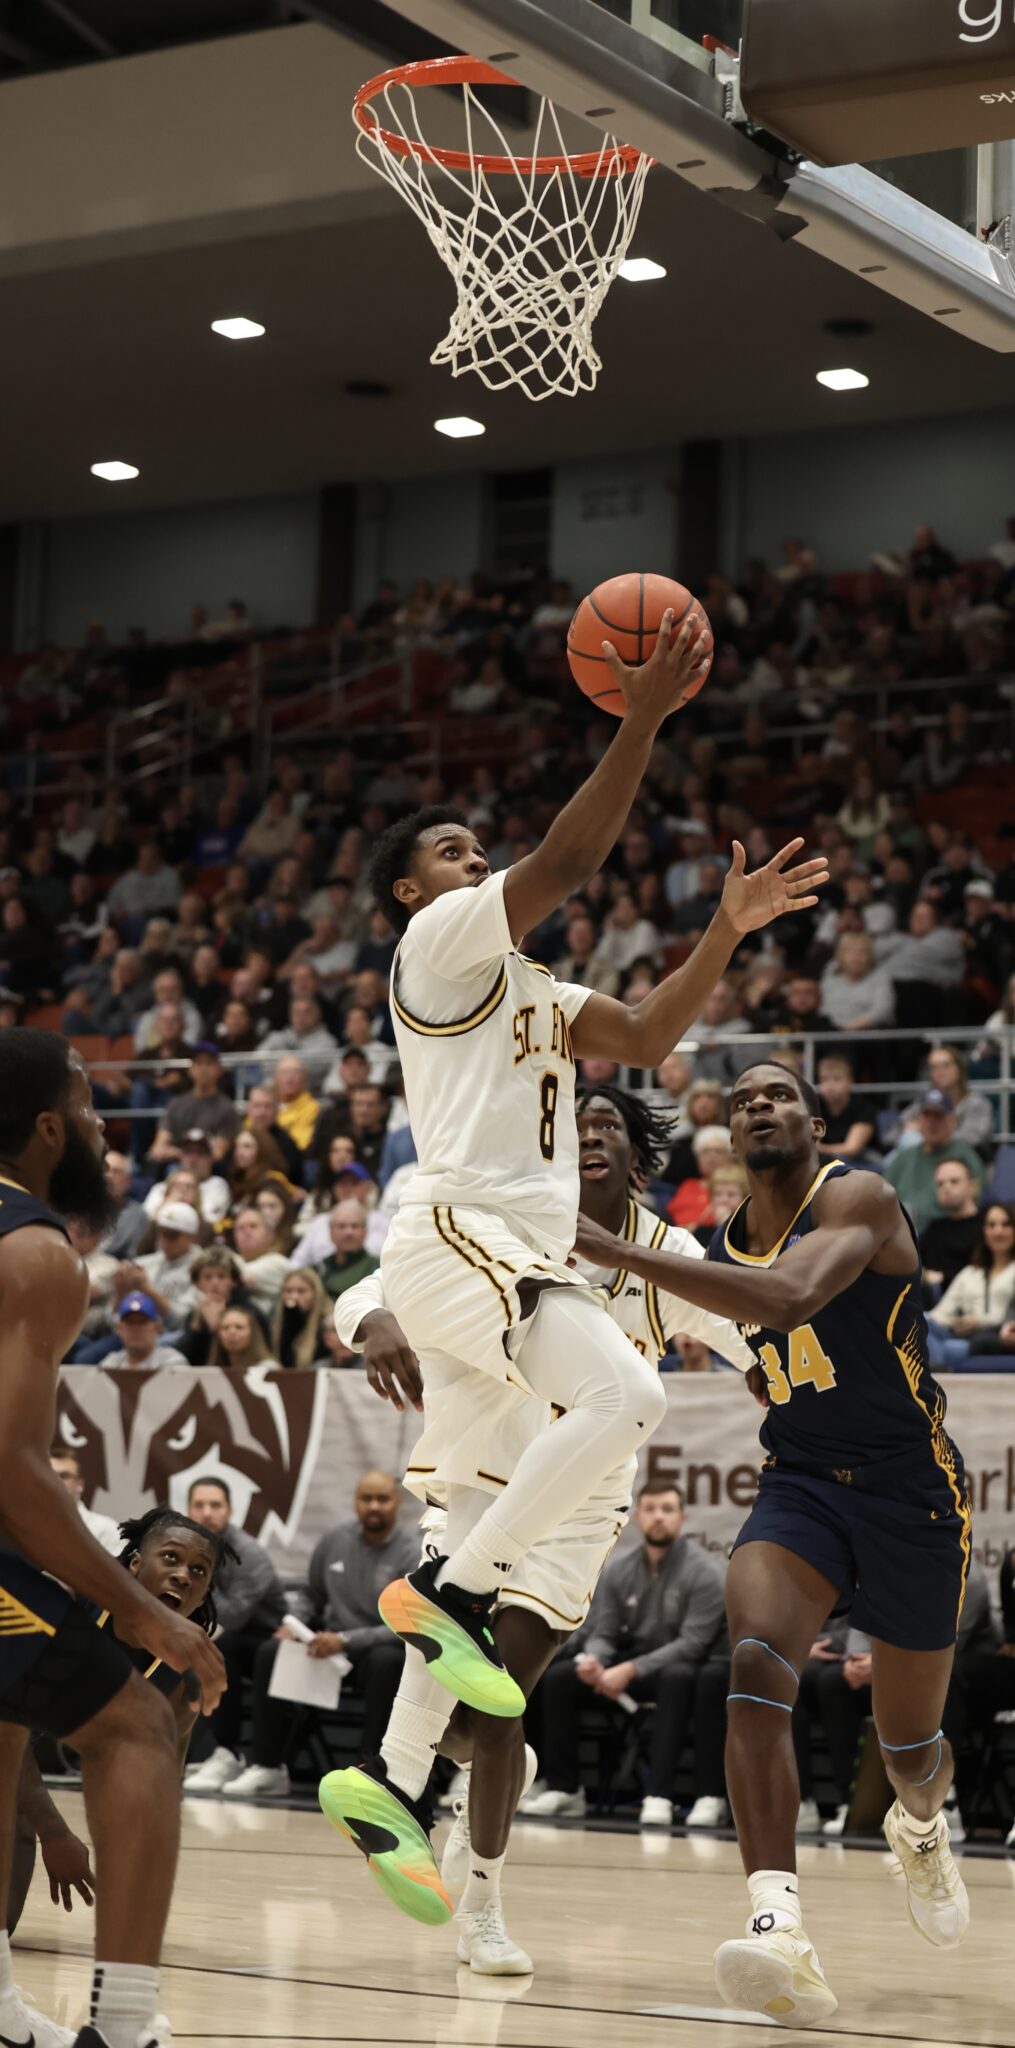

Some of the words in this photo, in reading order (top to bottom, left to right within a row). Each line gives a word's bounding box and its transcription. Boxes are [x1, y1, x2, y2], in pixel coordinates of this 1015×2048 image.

[540, 1071, 558, 1163] 8
[758, 1322, 838, 1405] 34
[647, 1445, 759, 1507] Ene
